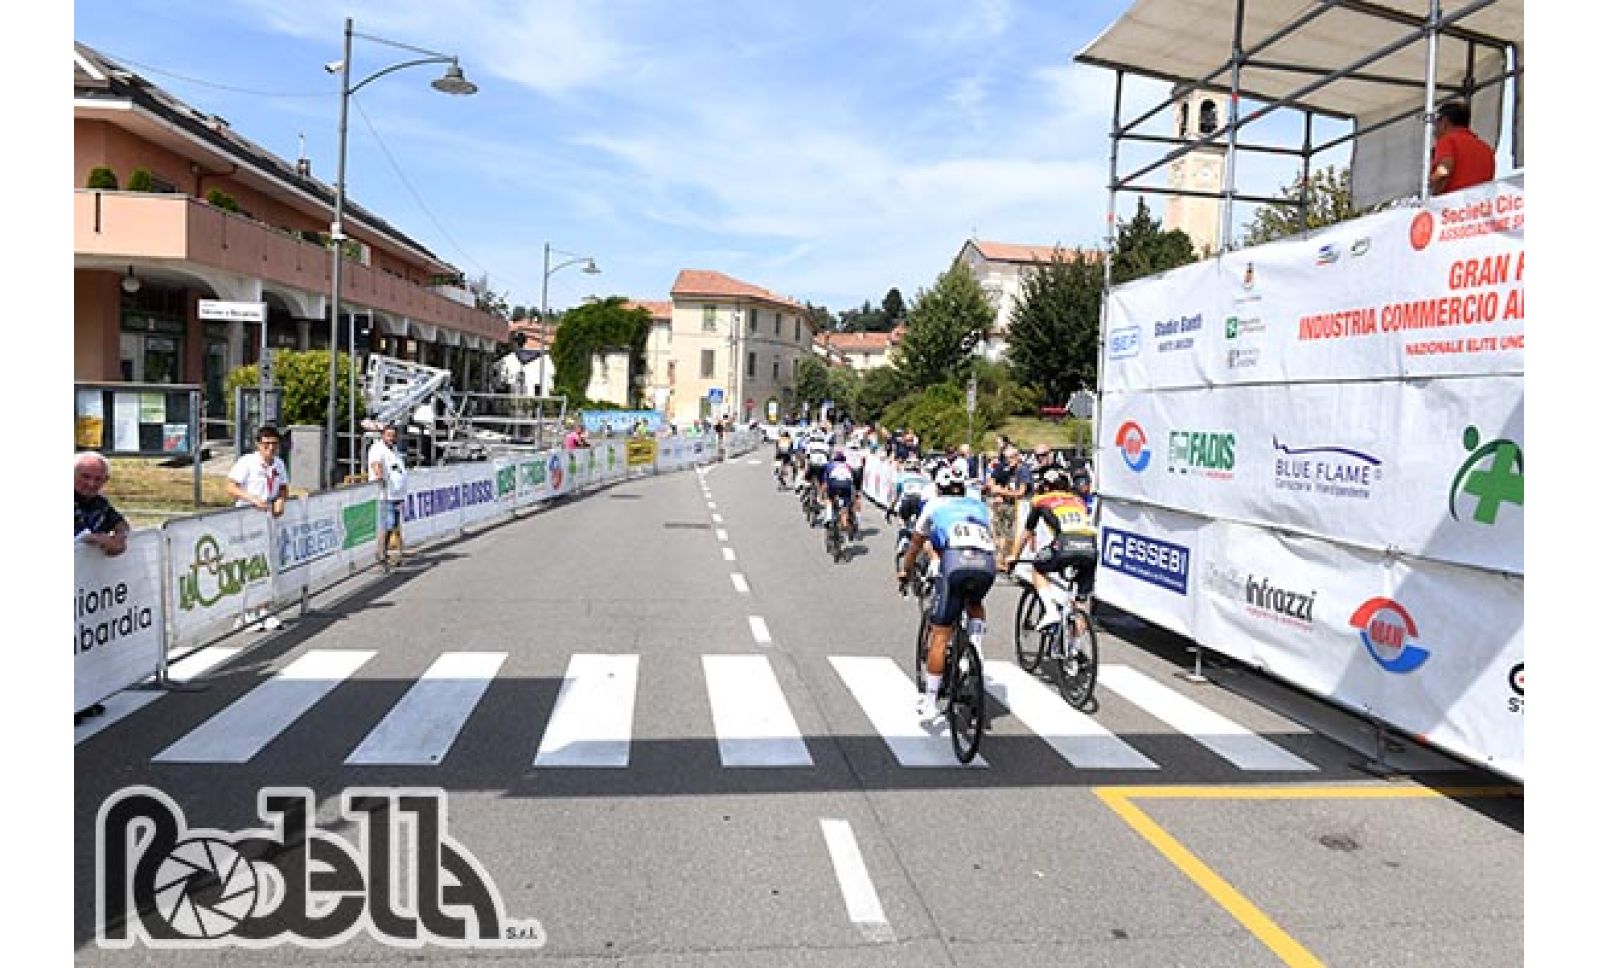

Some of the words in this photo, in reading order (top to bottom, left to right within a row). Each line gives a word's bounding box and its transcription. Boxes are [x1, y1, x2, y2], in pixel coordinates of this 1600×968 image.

[1449, 253, 1510, 290] GRAN
[1298, 308, 1377, 341] INDUSTRIA
[1381, 291, 1499, 333] COMMERCIO
[1275, 458, 1311, 479] BLUE
[1315, 462, 1371, 486] FLAME
[1126, 538, 1187, 576] ESSEBI
[74, 582, 128, 622] ione
[74, 605, 152, 655] bardia
